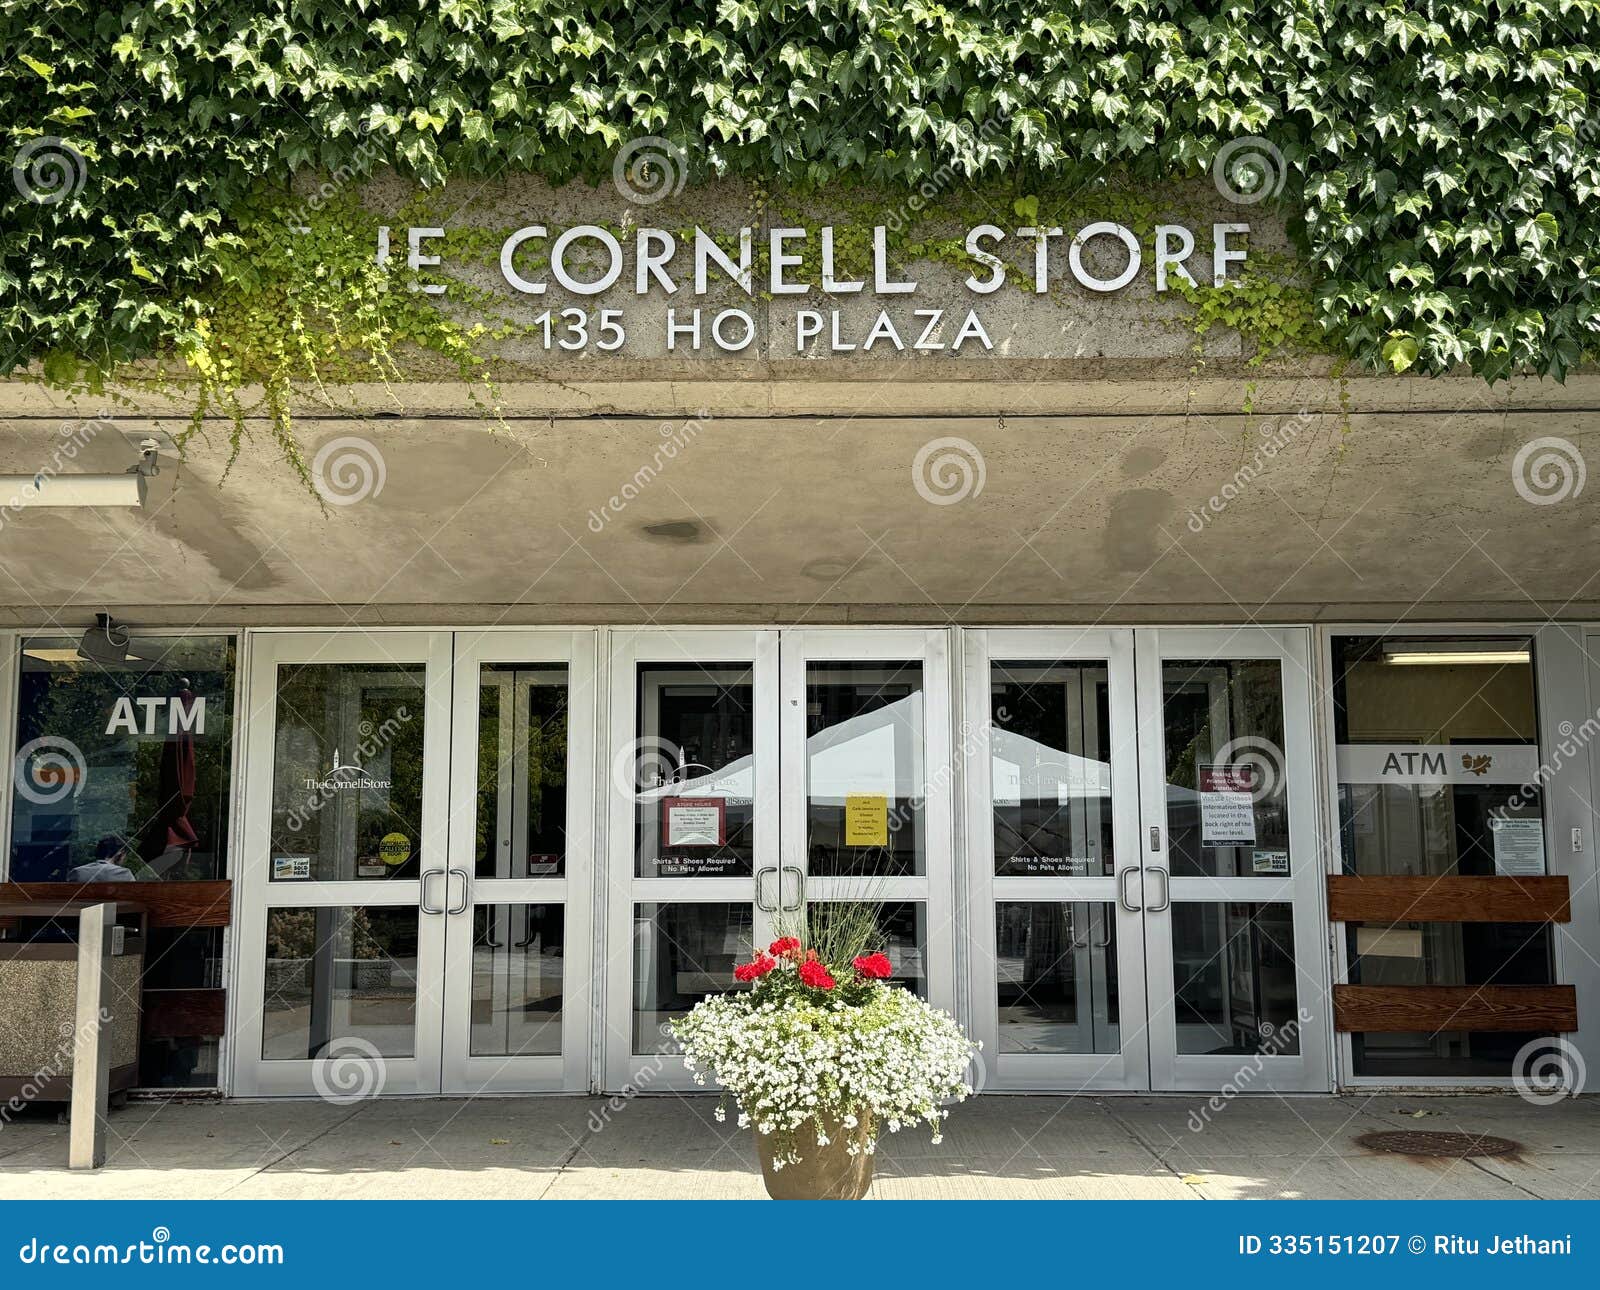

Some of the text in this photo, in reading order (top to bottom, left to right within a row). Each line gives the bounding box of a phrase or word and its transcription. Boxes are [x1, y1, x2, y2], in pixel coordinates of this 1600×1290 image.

[500, 225, 917, 295] CORNELL
[965, 221, 1250, 294] STORE
[534, 308, 994, 351] 135 HO PLAZA
[105, 697, 206, 735] ATM
[1382, 752, 1447, 775] ATM
